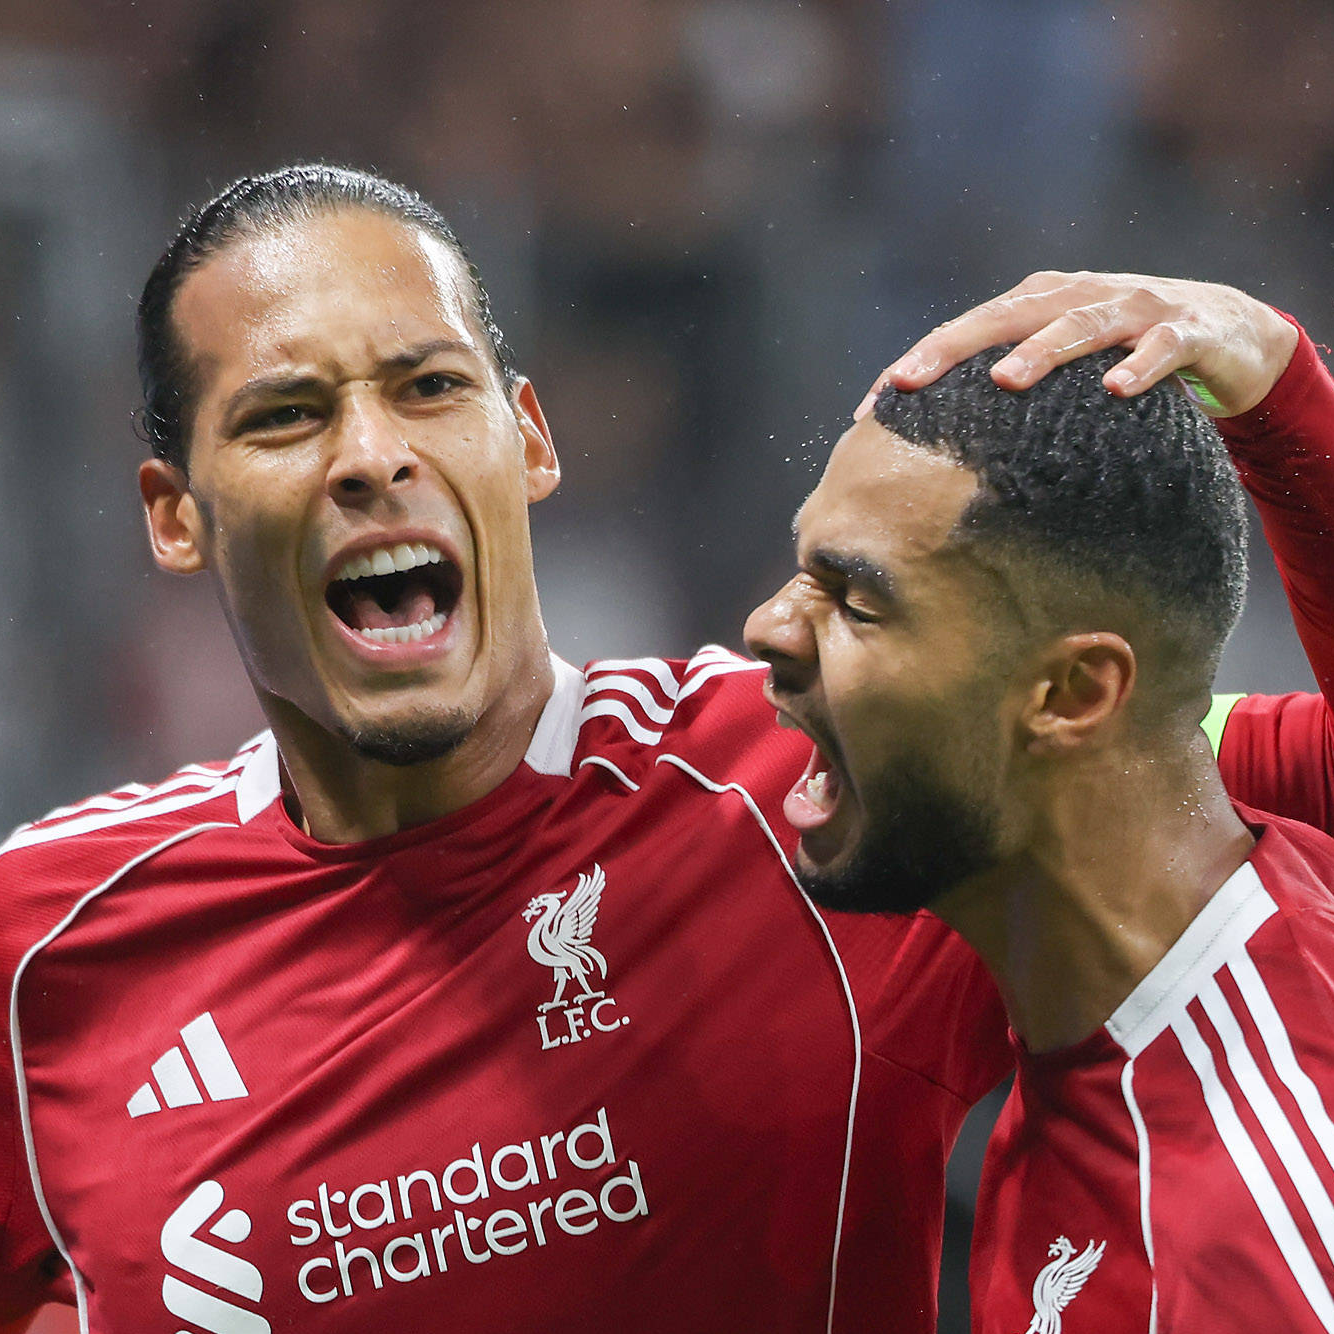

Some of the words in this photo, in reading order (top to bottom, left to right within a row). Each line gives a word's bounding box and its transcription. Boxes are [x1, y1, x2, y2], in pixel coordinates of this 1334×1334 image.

[536, 997, 631, 1051] L.F.C.
[286, 1106, 616, 1247] standard
[297, 1159, 650, 1304] chartered
